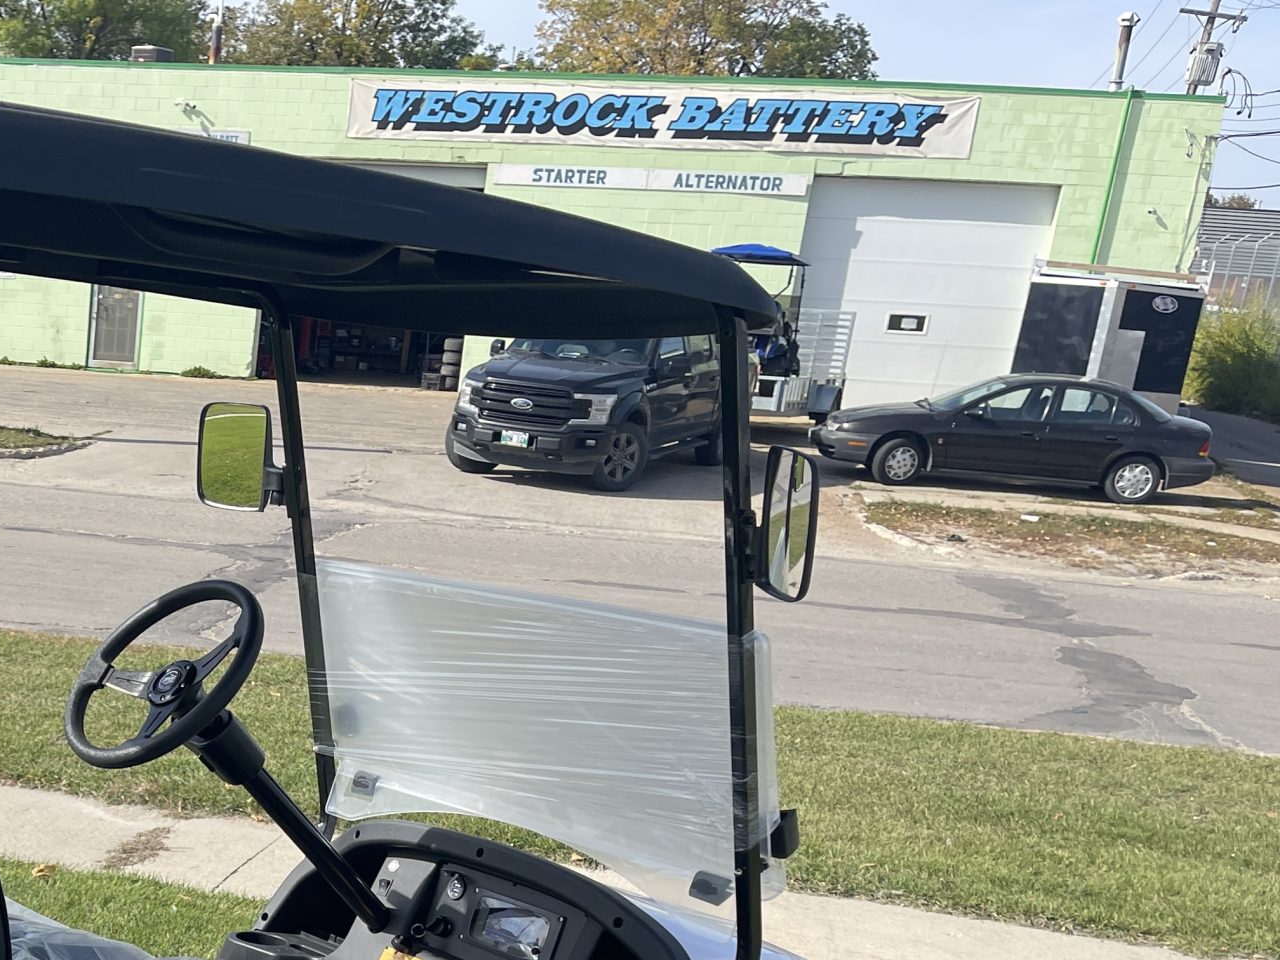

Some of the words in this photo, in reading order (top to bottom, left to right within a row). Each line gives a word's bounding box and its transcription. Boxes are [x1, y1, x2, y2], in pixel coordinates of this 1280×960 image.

[371, 89, 671, 138] WESTROCK
[667, 97, 949, 147] BATTERY
[532, 168, 607, 185] STARTER
[673, 173, 783, 192] ALTERNATOR
